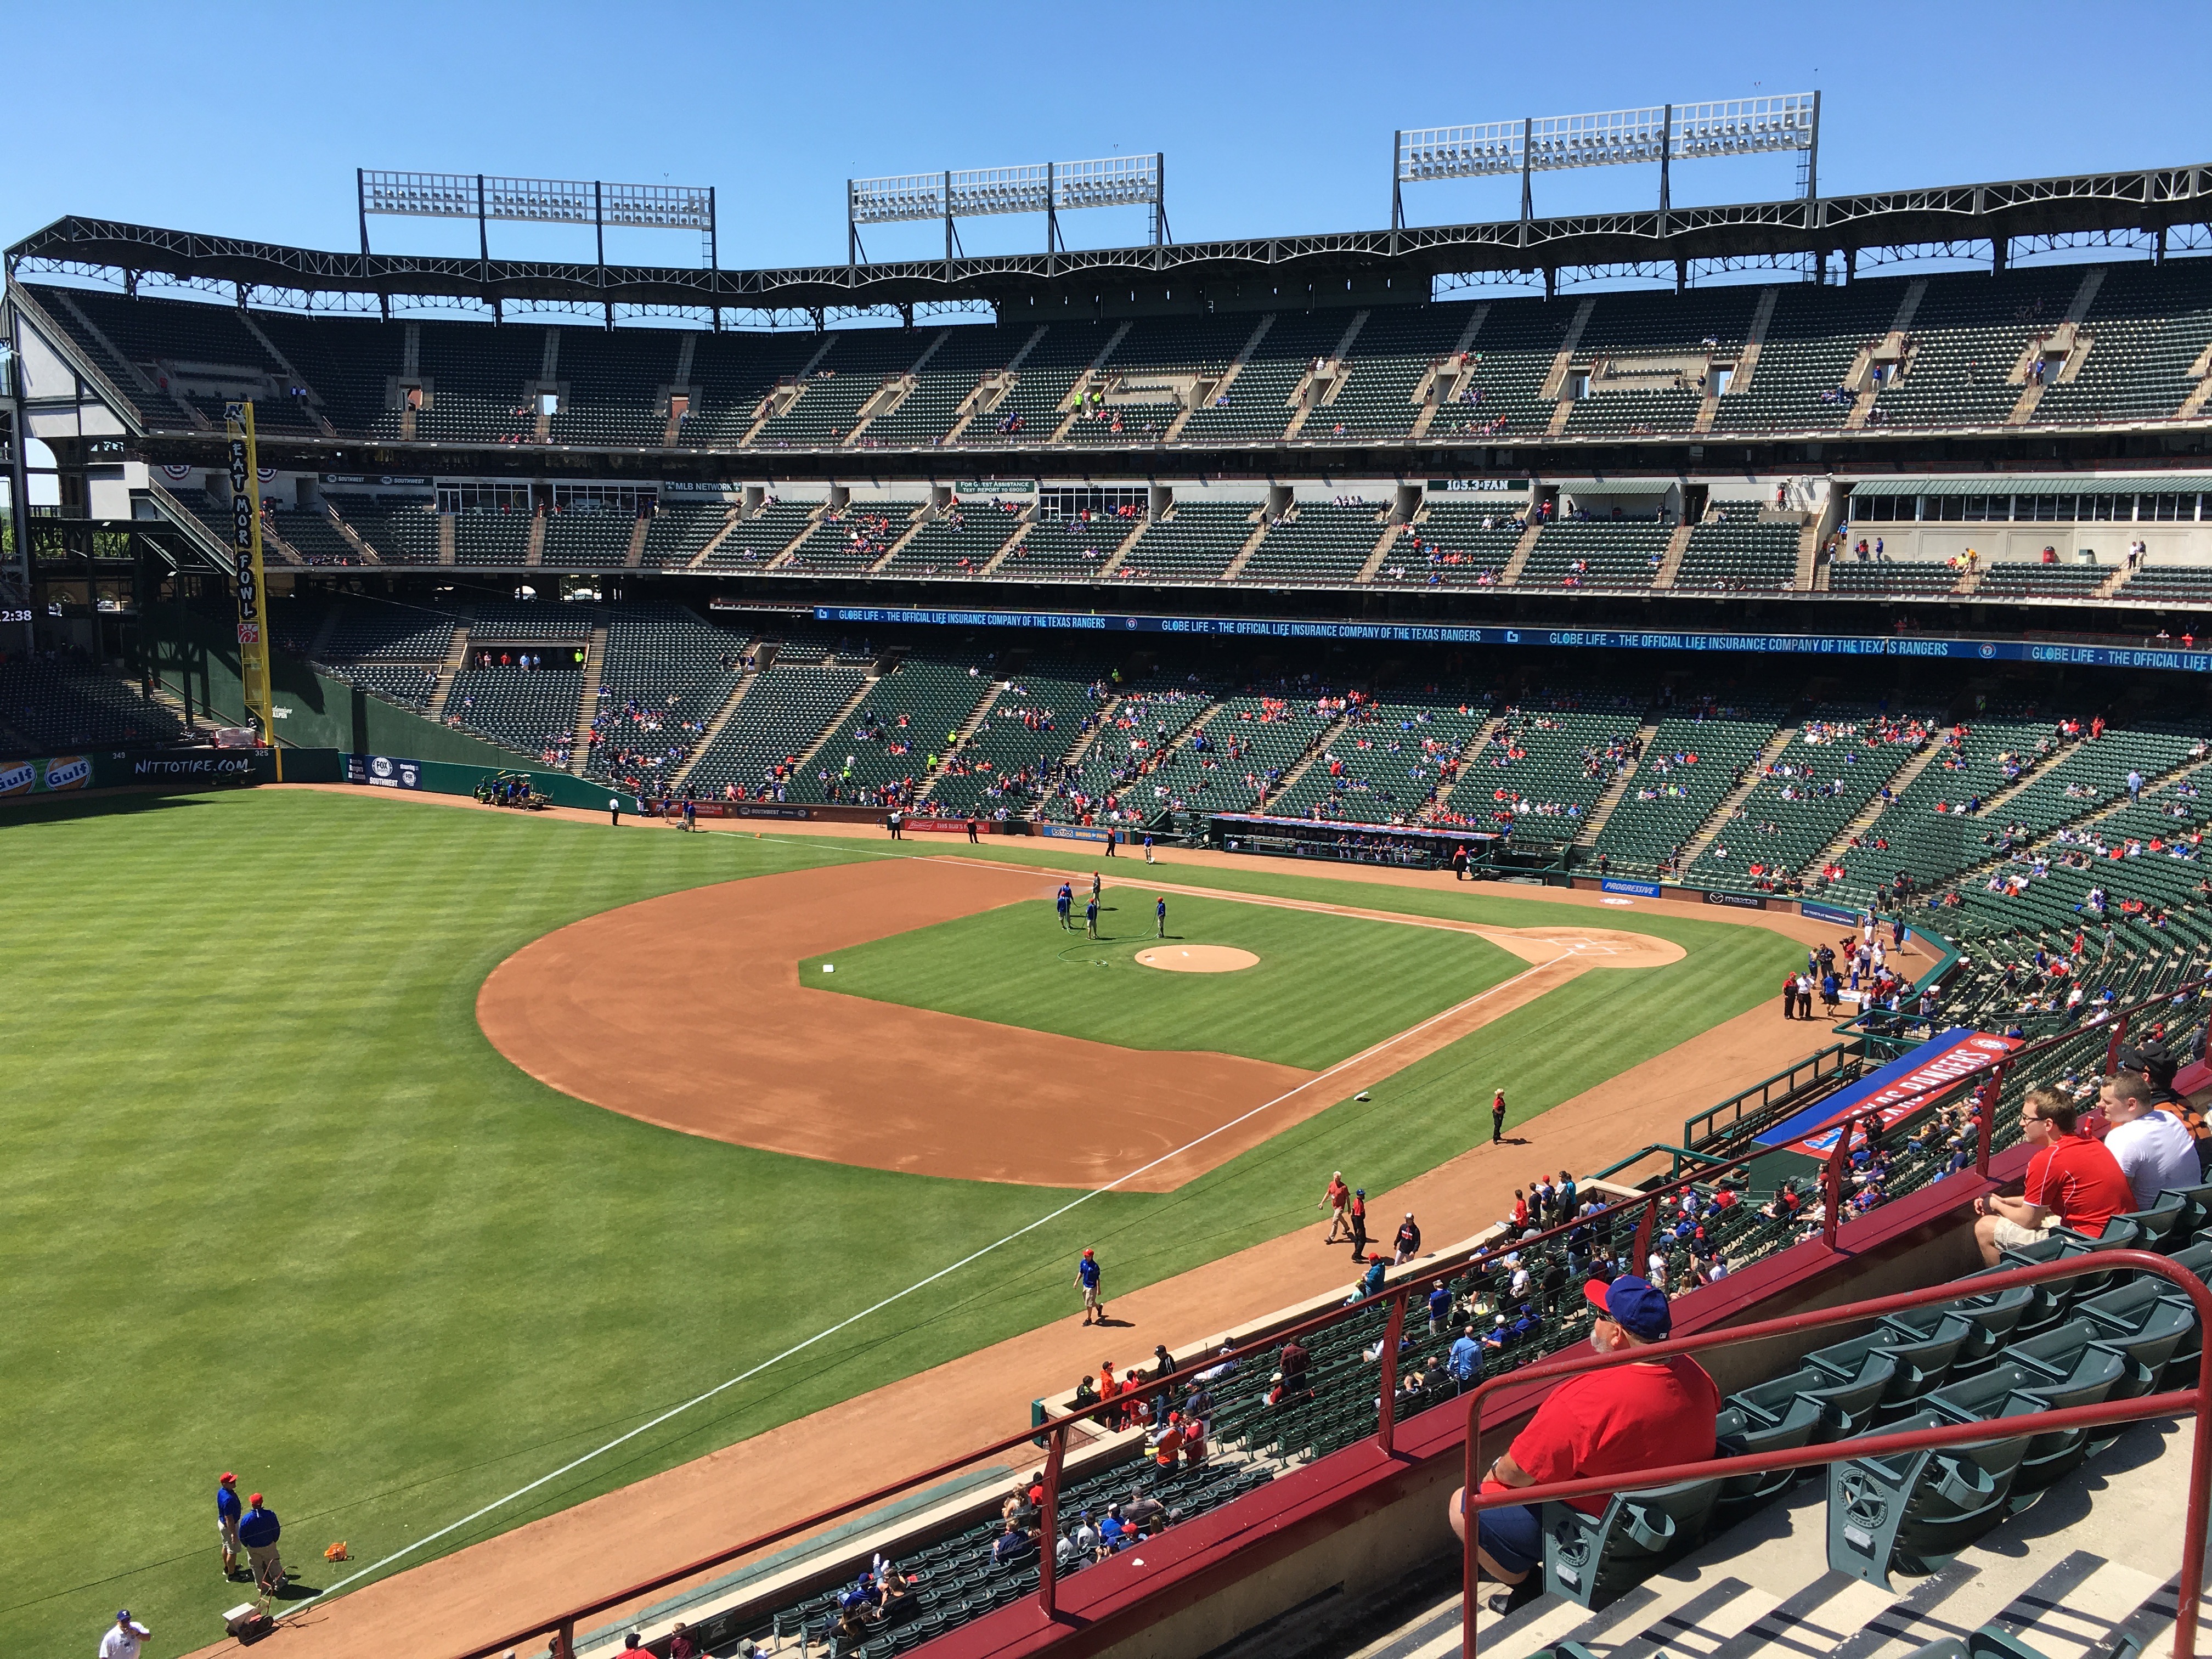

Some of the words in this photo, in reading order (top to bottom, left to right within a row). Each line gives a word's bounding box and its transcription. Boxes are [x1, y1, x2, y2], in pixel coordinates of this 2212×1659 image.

[233, 443, 245, 489] EAT
[675, 482, 694, 490] MLB
[696, 483, 732, 491] NETWORK
[237, 498, 248, 545] MOR
[240, 555, 253, 616] FOWL
[0, 610, 32, 622] 2:38
[839, 610, 862, 619] GLOBE
[864, 611, 878, 620] LIFE
[887, 611, 900, 622] THE
[902, 612, 930, 623] OFFICIAL
[933, 613, 946, 623] LIFE
[948, 613, 986, 624] INSURANCE
[988, 614, 1021, 626] COMPANY
[1022, 616, 1031, 627] OF
[1032, 616, 1046, 627] THE
[1047, 616, 1070, 628] TEXAS
[1072, 617, 1105, 629] RANGERS
[1162, 620, 1189, 631] GLOBE
[1192, 621, 1209, 632] LIFE
[1218, 622, 1234, 633] THE
[1237, 622, 1271, 634] OFFICIAL
[1273, 623, 1289, 635] LIFE
[1291, 624, 1337, 636] INSURANCE
[1339, 625, 1379, 638] COMPANY
[1381, 627, 1391, 639] OF
[1393, 627, 1409, 639] THE
[1412, 628, 1439, 640] TEXAS
[1441, 629, 1481, 641] RANGERS
[1549, 633, 1583, 645] GLOBE
[1585, 633, 1607, 645] LIFE
[1619, 634, 1638, 646] THE
[1641, 635, 1683, 648] OFFICIAL
[1685, 636, 1706, 650] LIFE
[1708, 637, 1766, 651] INSURANCE
[1769, 638, 1818, 651] COMPANY
[1821, 639, 1834, 652] OF
[1837, 640, 1857, 653] THE
[1860, 640, 1897, 654] TEXAS
[1899, 641, 1948, 656] RANGERS
[2032, 646, 2068, 662] GLOBE
[2072, 648, 2094, 662] LIFE
[2108, 650, 2130, 665] THE
[2134, 652, 2180, 668] OFFICIAL
[2183, 655, 2208, 670] LIFE
[48, 763, 87, 785] Gulf
[135, 758, 249, 774] NITTOTIRE.COM
[376, 760, 388, 770] FOX
[369, 776, 398, 787] SOUTHWEST
[1605, 881, 1655, 894] PROGRESSIVE
[1899, 1049, 1991, 1093] RANGERS
[1854, 1532, 1860, 1541] 2
